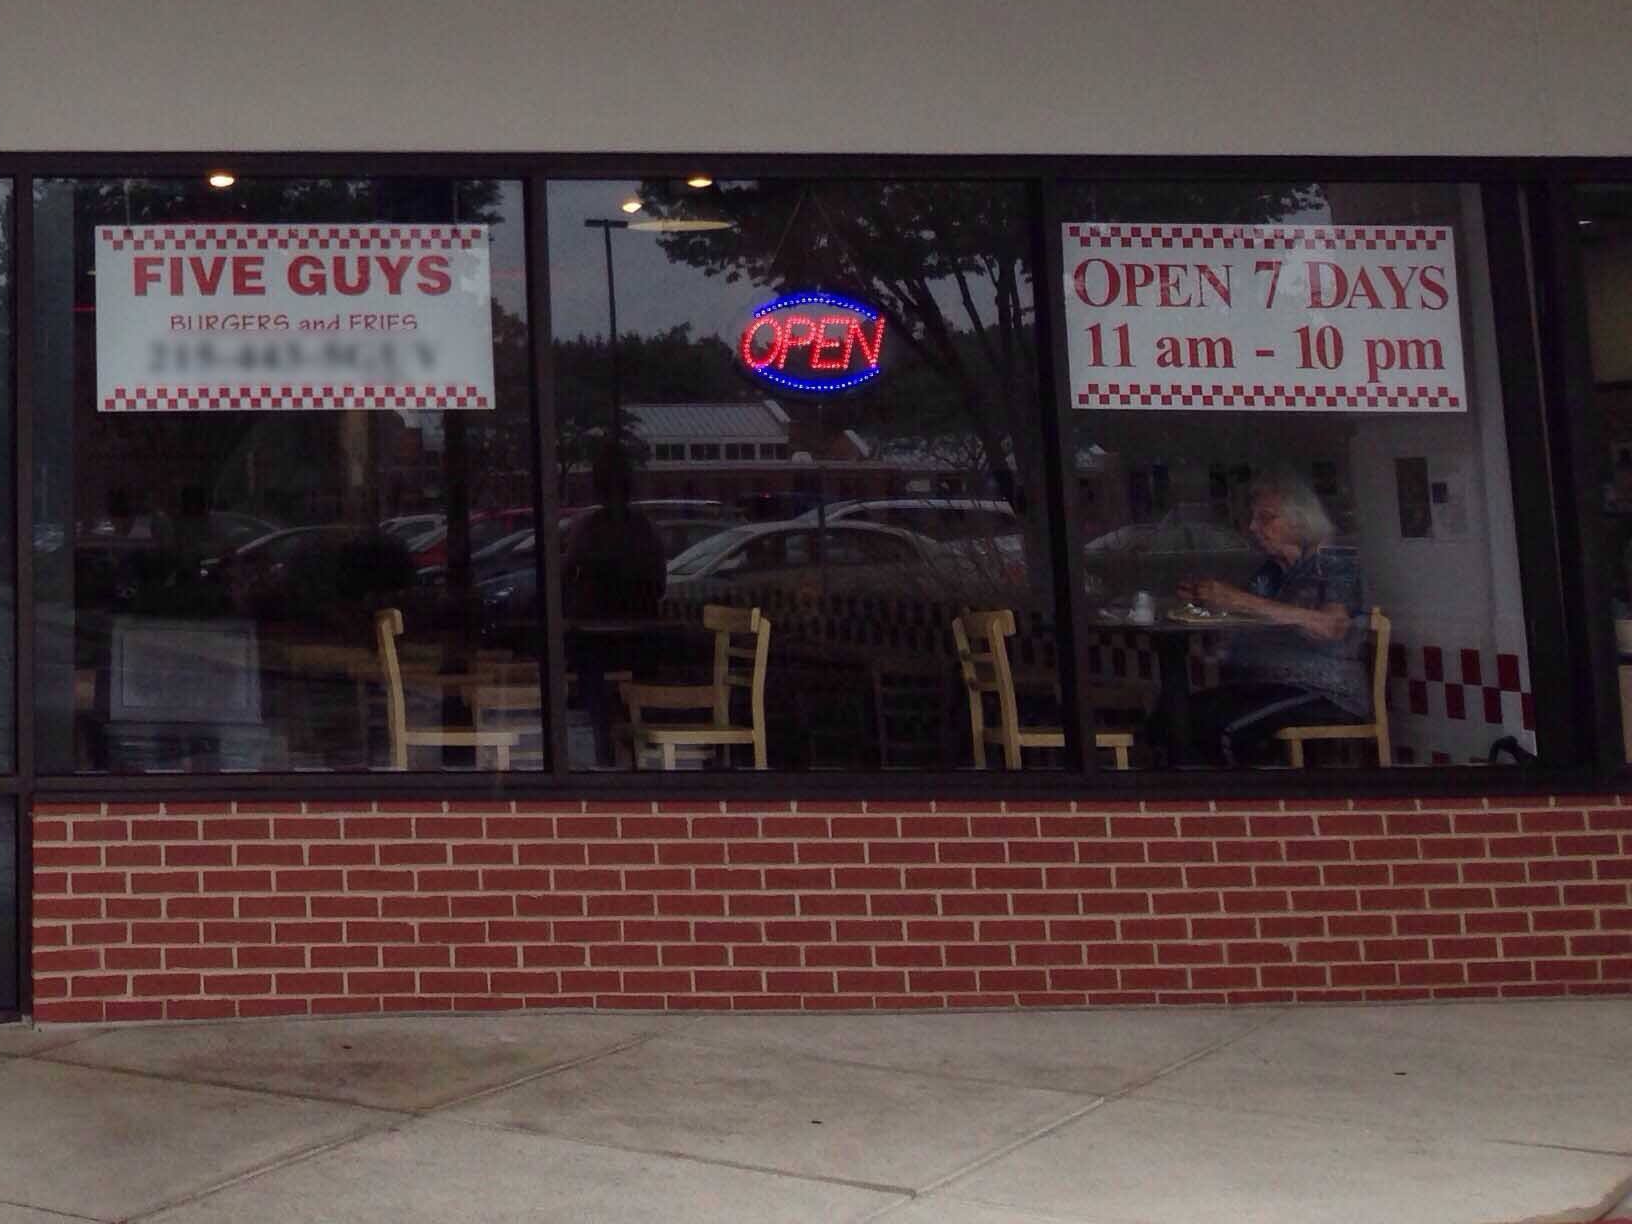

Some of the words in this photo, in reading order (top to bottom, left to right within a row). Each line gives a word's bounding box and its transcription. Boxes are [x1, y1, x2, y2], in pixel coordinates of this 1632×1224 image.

[133, 256, 266, 296] FIVE
[287, 255, 453, 296] GUYS
[1073, 258, 1233, 308] OPEN
[1255, 260, 1282, 309] 7
[1305, 260, 1450, 310] DAYS
[298, 313, 340, 331] and
[739, 313, 886, 370] OPEN
[1084, 322, 1136, 368] 11
[1156, 335, 1237, 369] am
[1294, 325, 1344, 369] 10
[1364, 336, 1447, 383] pm
